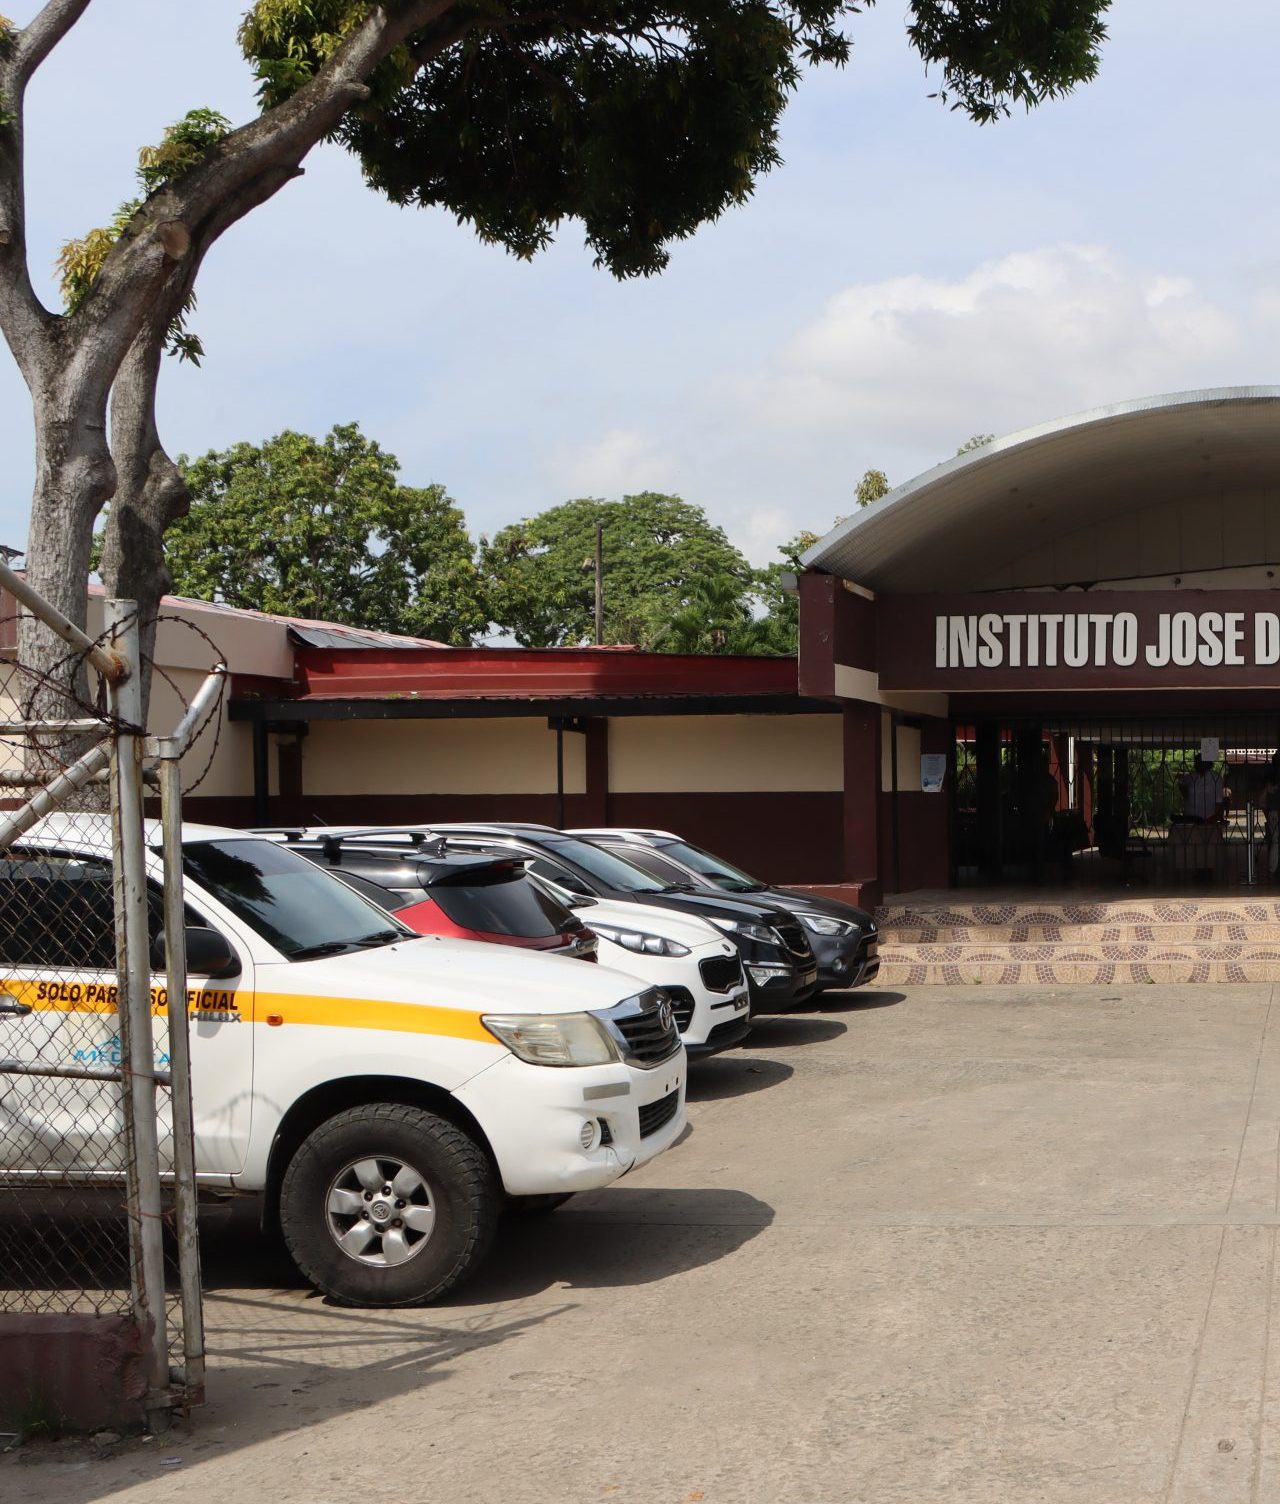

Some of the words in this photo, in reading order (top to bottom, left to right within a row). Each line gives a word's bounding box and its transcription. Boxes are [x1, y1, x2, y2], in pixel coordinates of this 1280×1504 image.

[935, 612, 1138, 668] INSTITUTO
[1145, 611, 1245, 667] JOSE
[37, 982, 80, 1002] SOLO
[86, 985, 120, 1004] PAR
[146, 988, 168, 1006] SO
[184, 990, 239, 1010] FICIAL
[189, 1011, 242, 1023] HILUX
